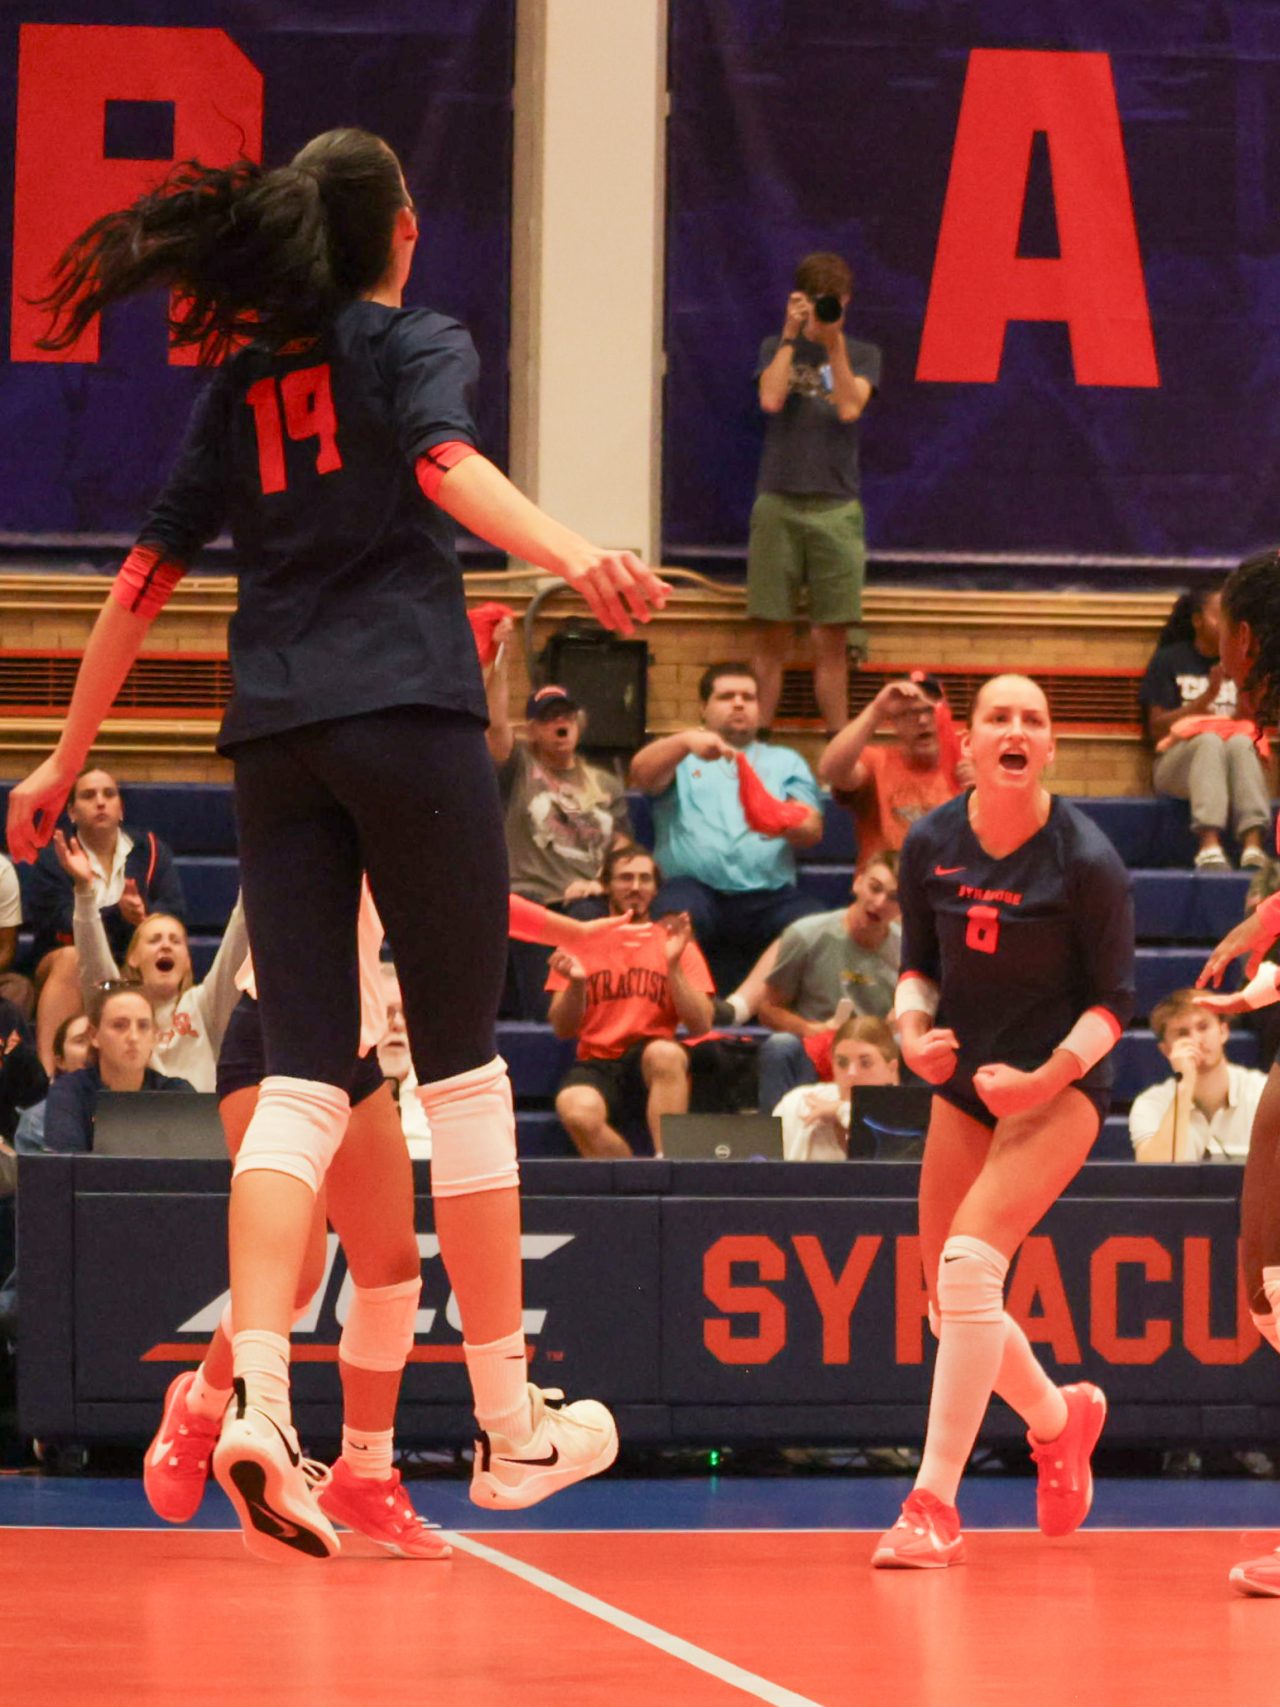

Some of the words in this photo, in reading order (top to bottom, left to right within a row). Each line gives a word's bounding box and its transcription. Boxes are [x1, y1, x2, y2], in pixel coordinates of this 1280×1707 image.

[914, 48, 1161, 388] A
[245, 362, 344, 497] 19
[586, 966, 668, 1008] YRACUS
